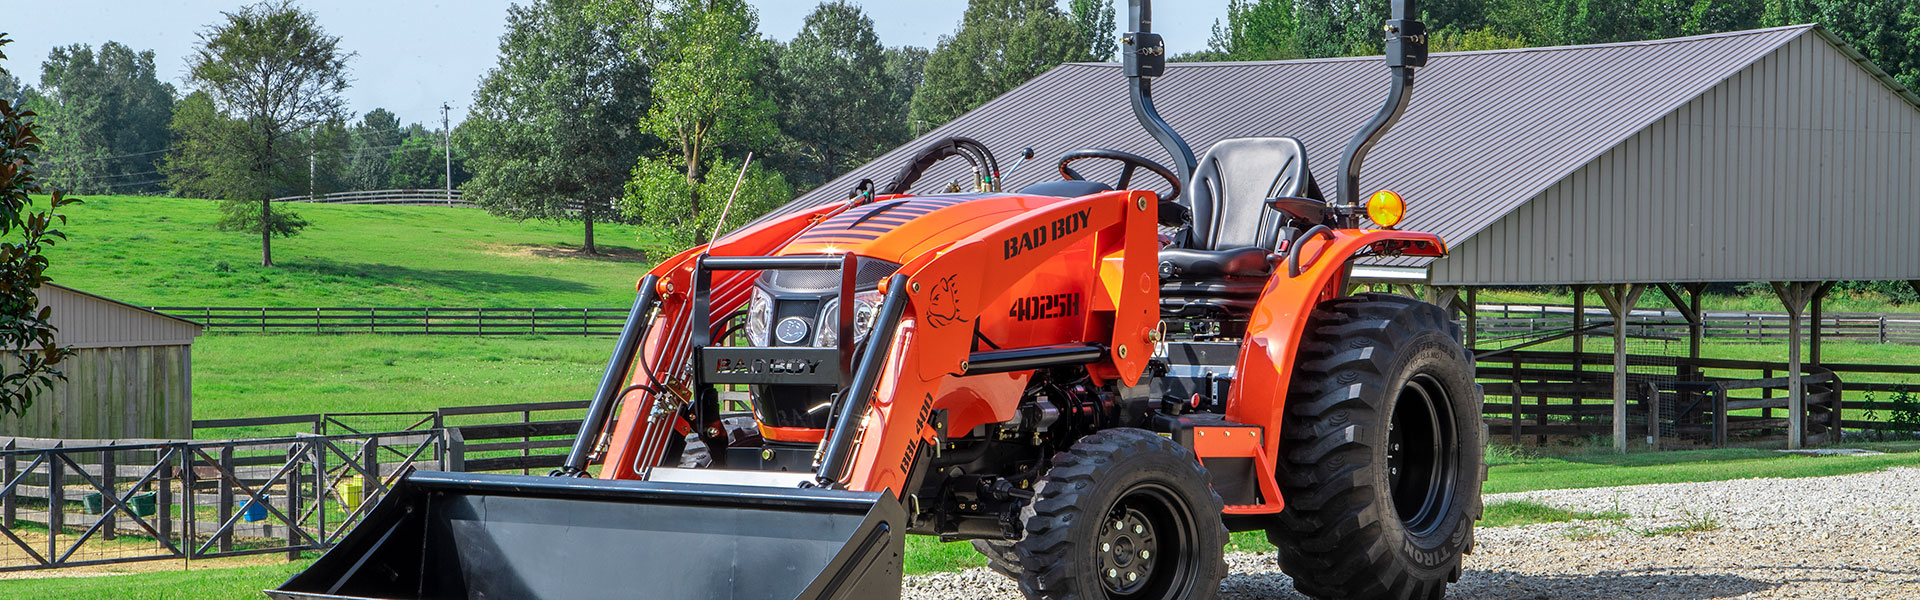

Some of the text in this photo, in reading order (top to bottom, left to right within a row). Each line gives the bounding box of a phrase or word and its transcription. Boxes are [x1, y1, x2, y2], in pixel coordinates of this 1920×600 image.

[1003, 206, 1092, 260] BAD BOY
[1009, 292, 1080, 321] 4025H
[716, 358, 823, 375] BAD BOY
[899, 391, 934, 475] BBL 400
[1404, 538, 1451, 567] TIRON
